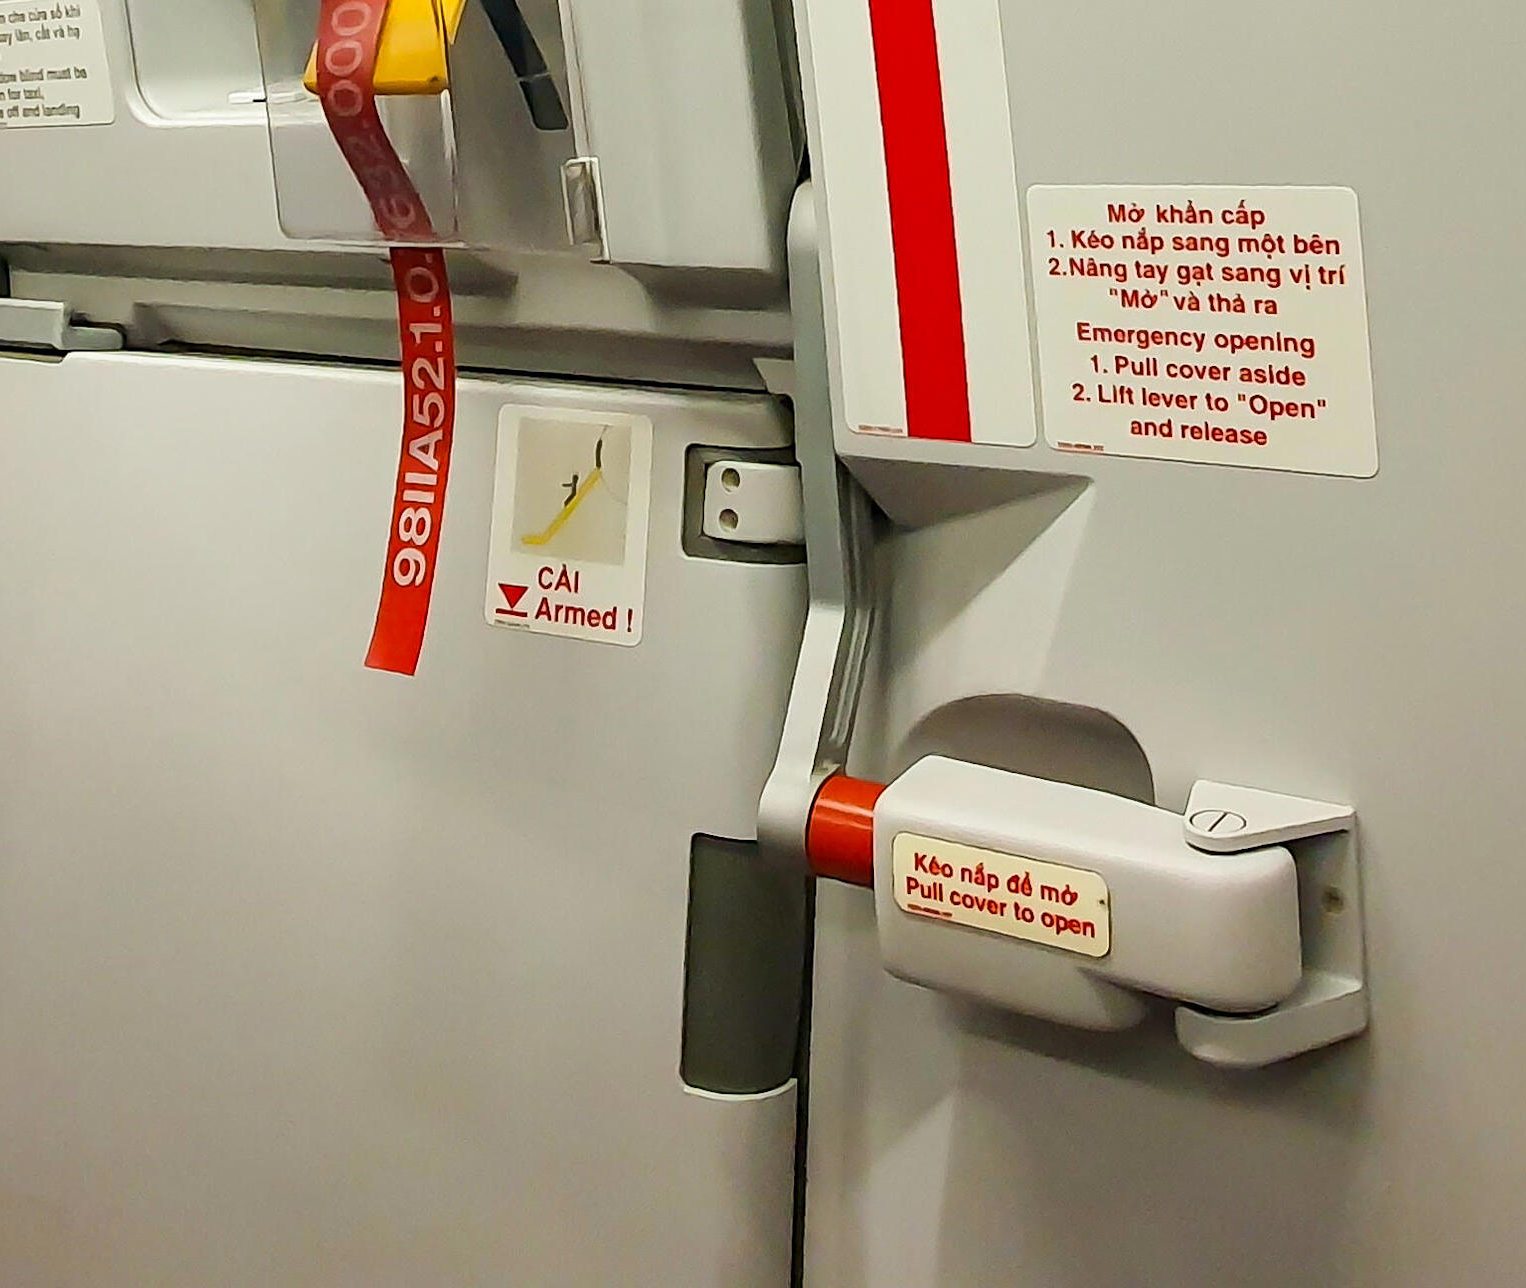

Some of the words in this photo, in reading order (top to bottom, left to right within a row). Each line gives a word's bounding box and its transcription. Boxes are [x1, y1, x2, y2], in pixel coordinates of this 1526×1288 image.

[1107, 202, 1145, 224] Mở
[1156, 200, 1213, 225] khẩn
[1221, 199, 1265, 230] cấp
[1046, 230, 1064, 248] 1.
[1071, 229, 1114, 250] Kéo
[1122, 227, 1164, 255] nắp
[1172, 235, 1230, 257] sang
[1238, 234, 1284, 259] một
[1293, 234, 1341, 255] bên
[1134, 261, 1168, 284] tay
[1177, 263, 1213, 287] gạt
[1222, 265, 1281, 289] sang
[1289, 264, 1312, 290] vị
[1317, 264, 1347, 286] trí
[1109, 288, 1168, 309] "Mở"
[1174, 291, 1200, 312] và
[1209, 293, 1246, 314] thả
[1254, 298, 1278, 315] ra
[1076, 322, 1206, 353] Emergency
[1214, 331, 1316, 358] opening
[1090, 355, 1108, 374] 1.
[1114, 355, 1158, 378] Pull
[1166, 362, 1231, 382] cover
[1239, 365, 1306, 386] aside
[1072, 384, 1091, 402] 2.
[1097, 384, 1134, 405] Lift
[1142, 387, 1197, 410] lever
[1205, 392, 1228, 412] to
[1237, 394, 1327, 420] "Open"
[1130, 418, 1173, 438] and
[1180, 421, 1268, 446] release
[534, 596, 617, 630] Armed
[626, 608, 634, 633] !
[914, 852, 954, 879] Kéo
[906, 876, 944, 903] Pull
[949, 890, 1008, 917] cover
[1014, 901, 1035, 924] to
[1040, 912, 1096, 939] open
